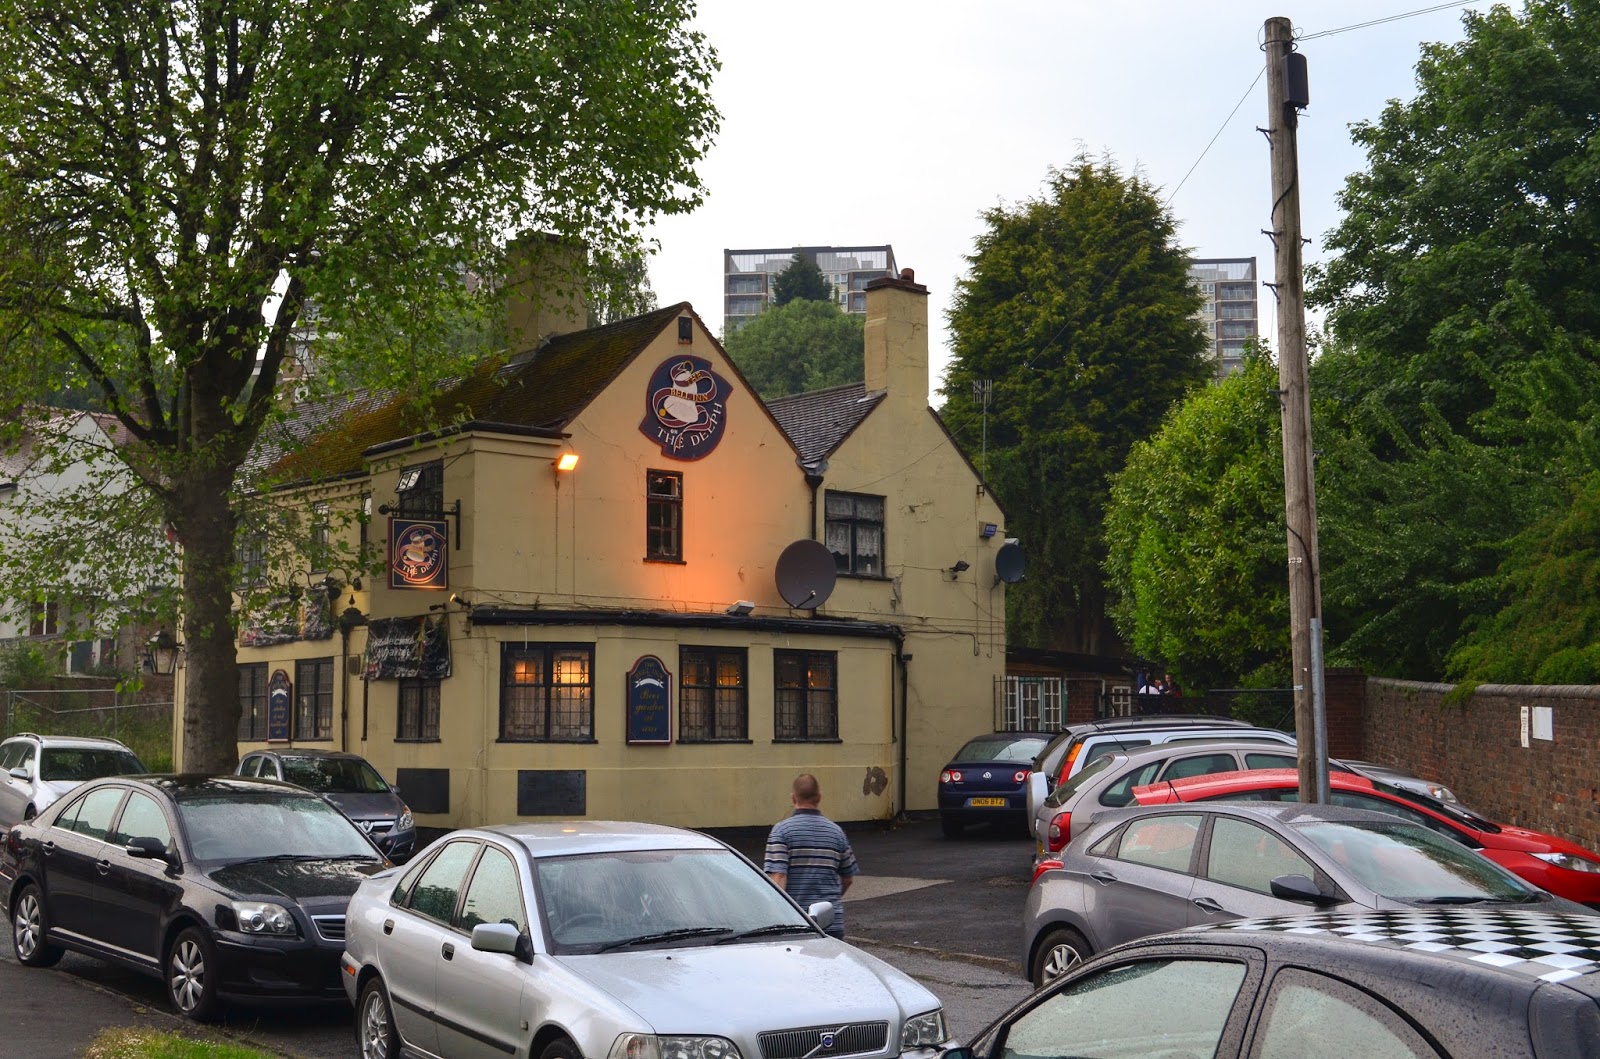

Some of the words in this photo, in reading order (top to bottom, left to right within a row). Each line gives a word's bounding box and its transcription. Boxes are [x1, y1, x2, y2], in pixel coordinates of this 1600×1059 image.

[671, 388, 690, 400] BELL
[692, 393, 709, 402] INN
[657, 426, 685, 448] THE
[690, 402, 723, 446] DELPH
